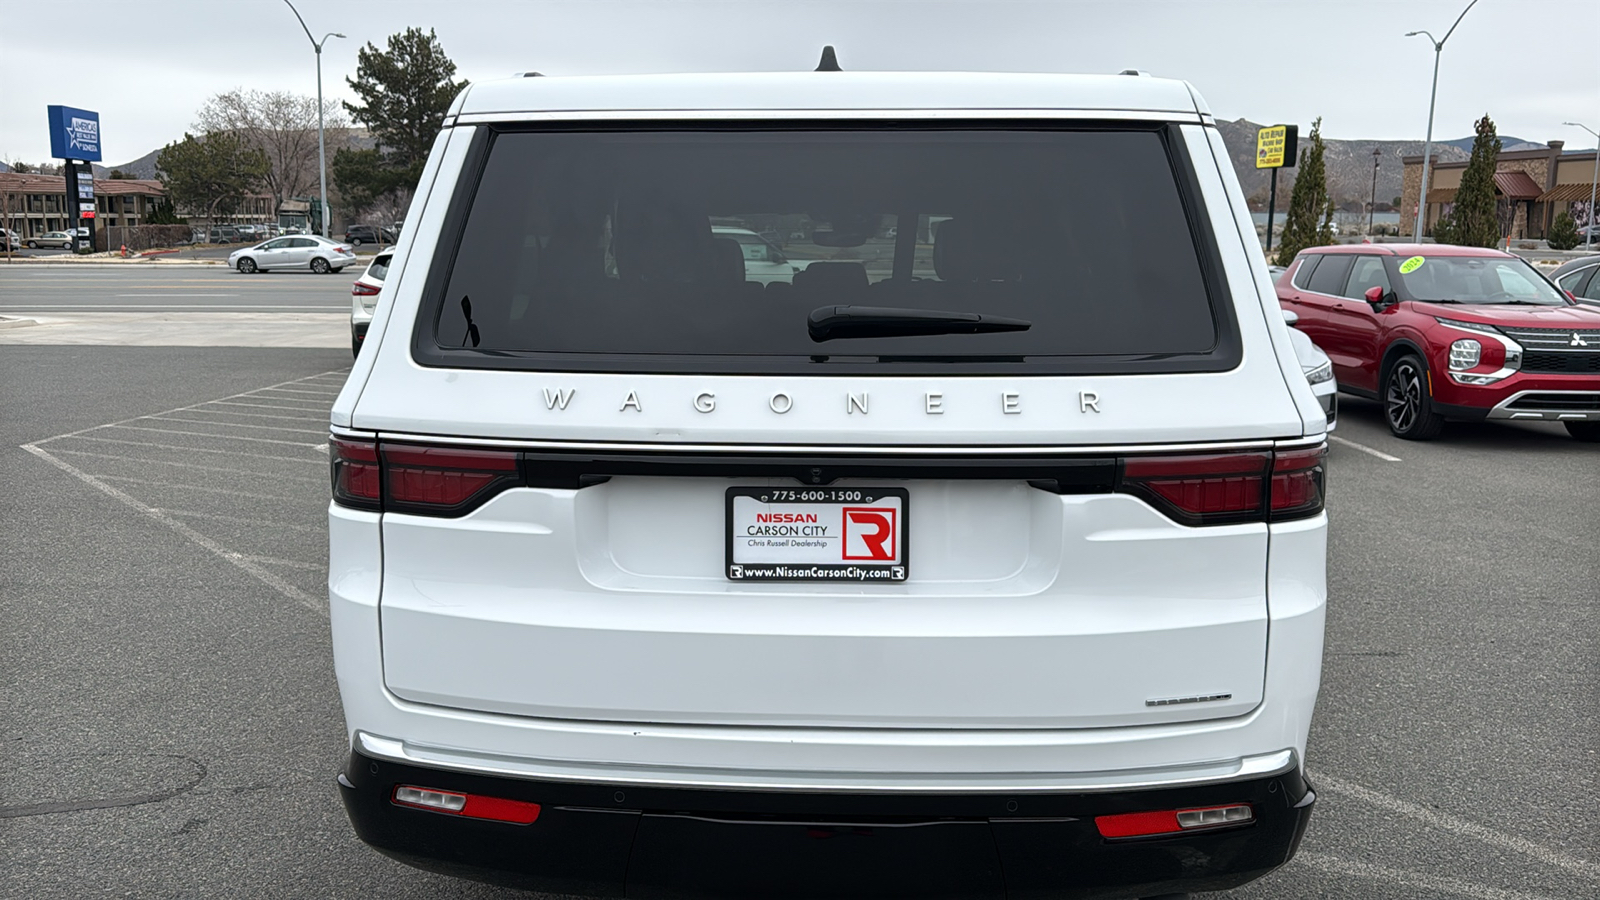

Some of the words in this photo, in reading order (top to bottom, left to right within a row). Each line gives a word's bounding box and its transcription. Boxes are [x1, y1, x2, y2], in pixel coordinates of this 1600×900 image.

[1271, 129, 1284, 138] REPAIR
[1402, 257, 1421, 272] 2024
[543, 387, 1103, 415] WAGONEER
[772, 490, 862, 501] 775-600-1500
[756, 513, 818, 523] NISSAN
[747, 525, 799, 536] CARSON
[802, 526, 828, 536] CITY
[747, 539, 765, 547] Chris
[767, 539, 789, 547] Russell
[791, 539, 827, 548] Dealership
[744, 567, 890, 581] www.NissanCarsonCity.com
